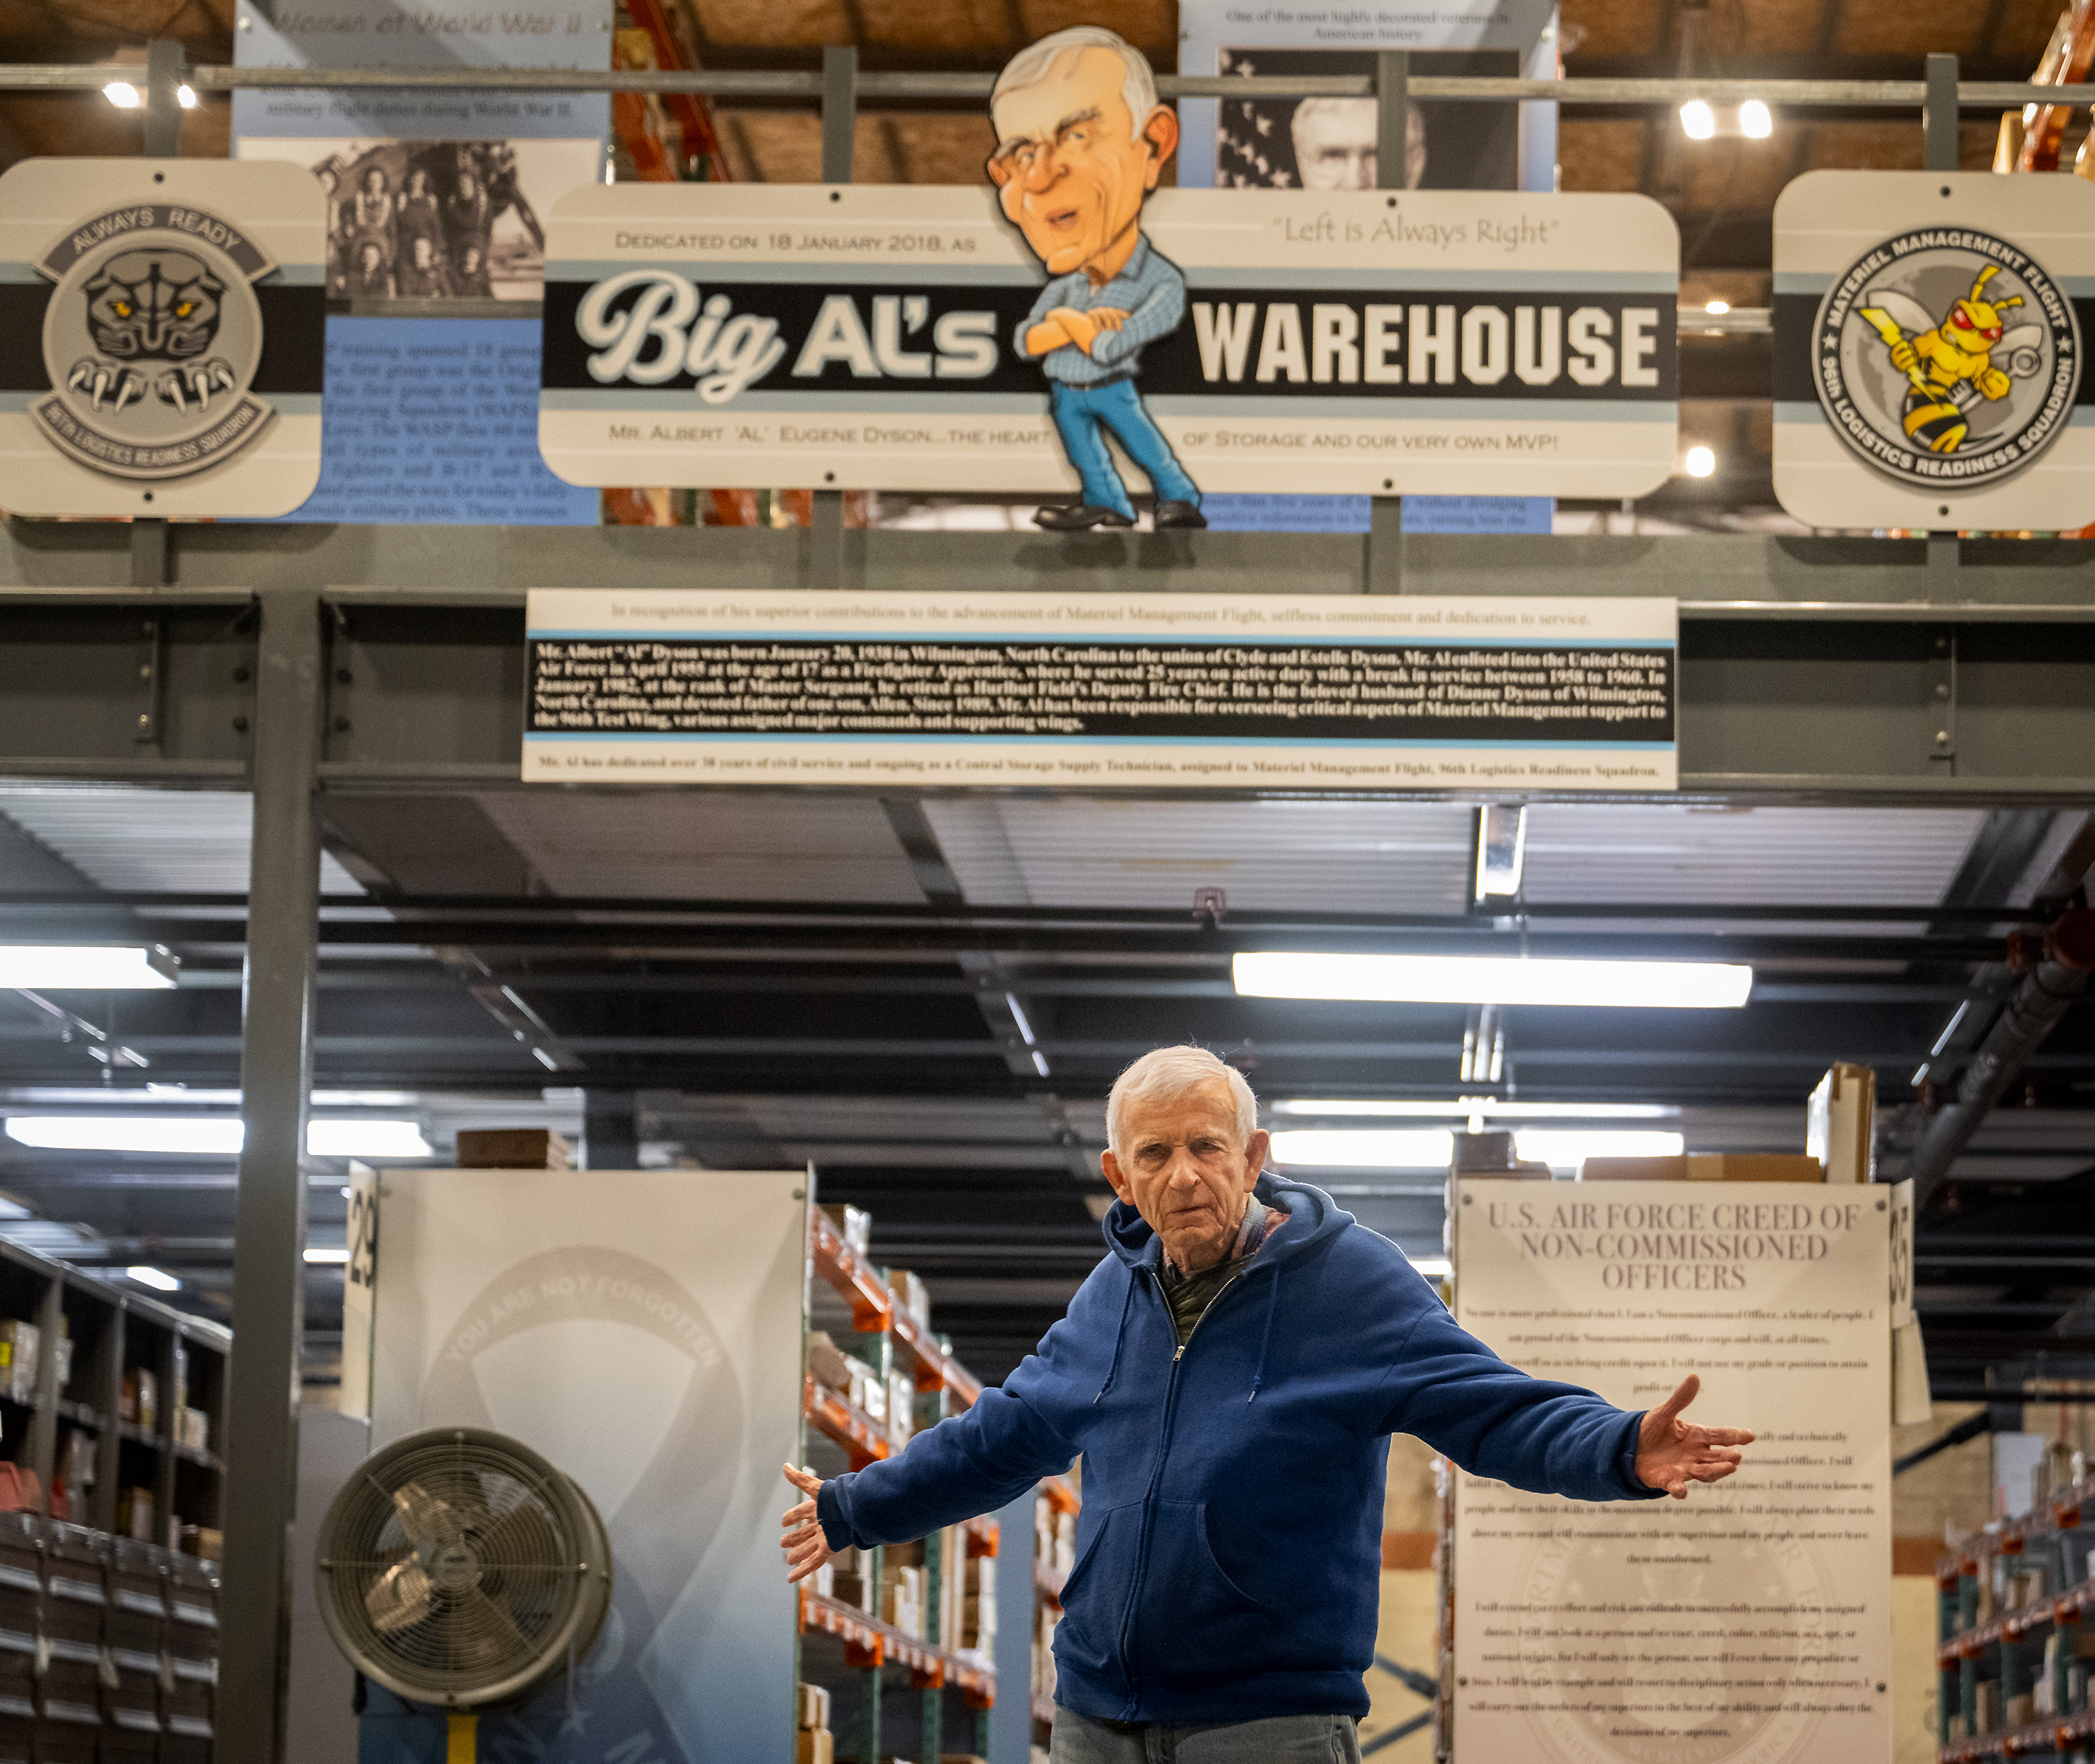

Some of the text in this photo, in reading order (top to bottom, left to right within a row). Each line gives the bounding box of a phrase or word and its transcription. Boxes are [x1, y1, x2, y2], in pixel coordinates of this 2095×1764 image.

[72, 209, 241, 255] ALWAYS READY
[769, 233, 793, 250] 18
[1345, 218, 1362, 242] is
[1370, 213, 1467, 251] Always
[1827, 230, 2068, 329] MATERIEL MANAGEMENT FLIGHT
[575, 270, 787, 404] Big
[1191, 302, 1660, 387] WAREHOUSE
[135, 441, 199, 467] READINESS
[198, 404, 256, 453] SQUADRON
[1835, 399, 1914, 470] LOGISTICS
[1915, 446, 2020, 478] READINESS
[2017, 357, 2073, 451] SQUADRON
[1505, 433, 1559, 450] MVP!
[611, 604, 1590, 625] In recognition of his superior contributions to the advancement of Materiel Management Flight, selfless commitment and dedication to service.
[351, 1189, 377, 1288] 29
[1488, 1203, 1860, 1233] U.S. AIR FORCE CREED OF
[1520, 1233, 1828, 1261] NON-COMMISSIONED
[1601, 1263, 1747, 1291] OFFICERS
[446, 1276, 720, 1368] YOU ARE NOT FORGOTTEN
